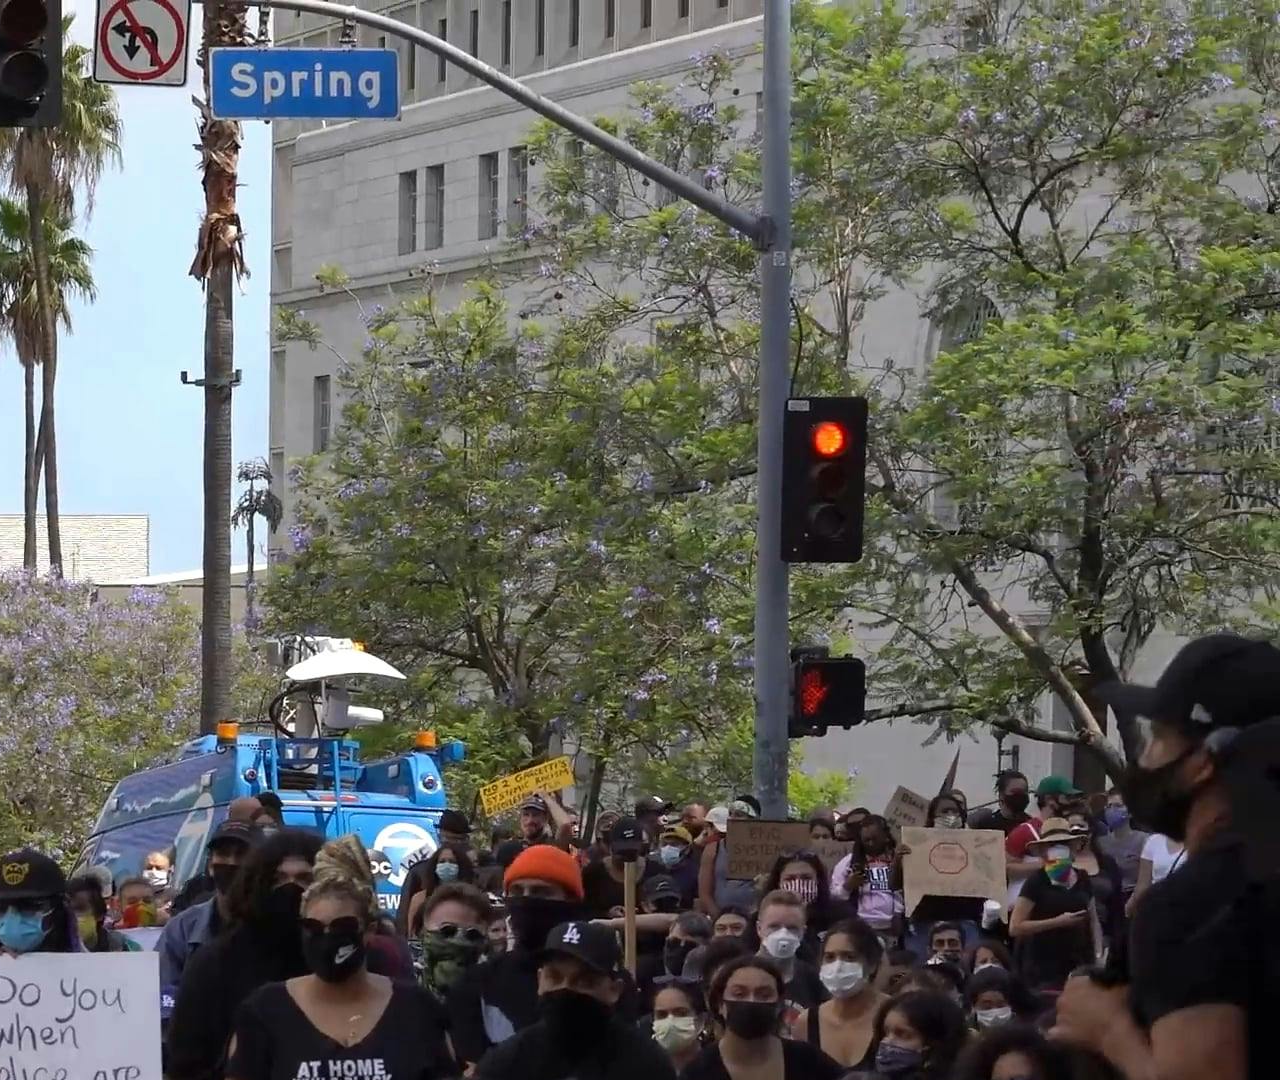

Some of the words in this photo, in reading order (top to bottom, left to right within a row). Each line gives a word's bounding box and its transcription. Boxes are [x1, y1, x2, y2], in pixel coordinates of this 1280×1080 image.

[230, 62, 381, 109] Spring
[296, 1060, 323, 1079] AT
[327, 1058, 386, 1078] HOME
